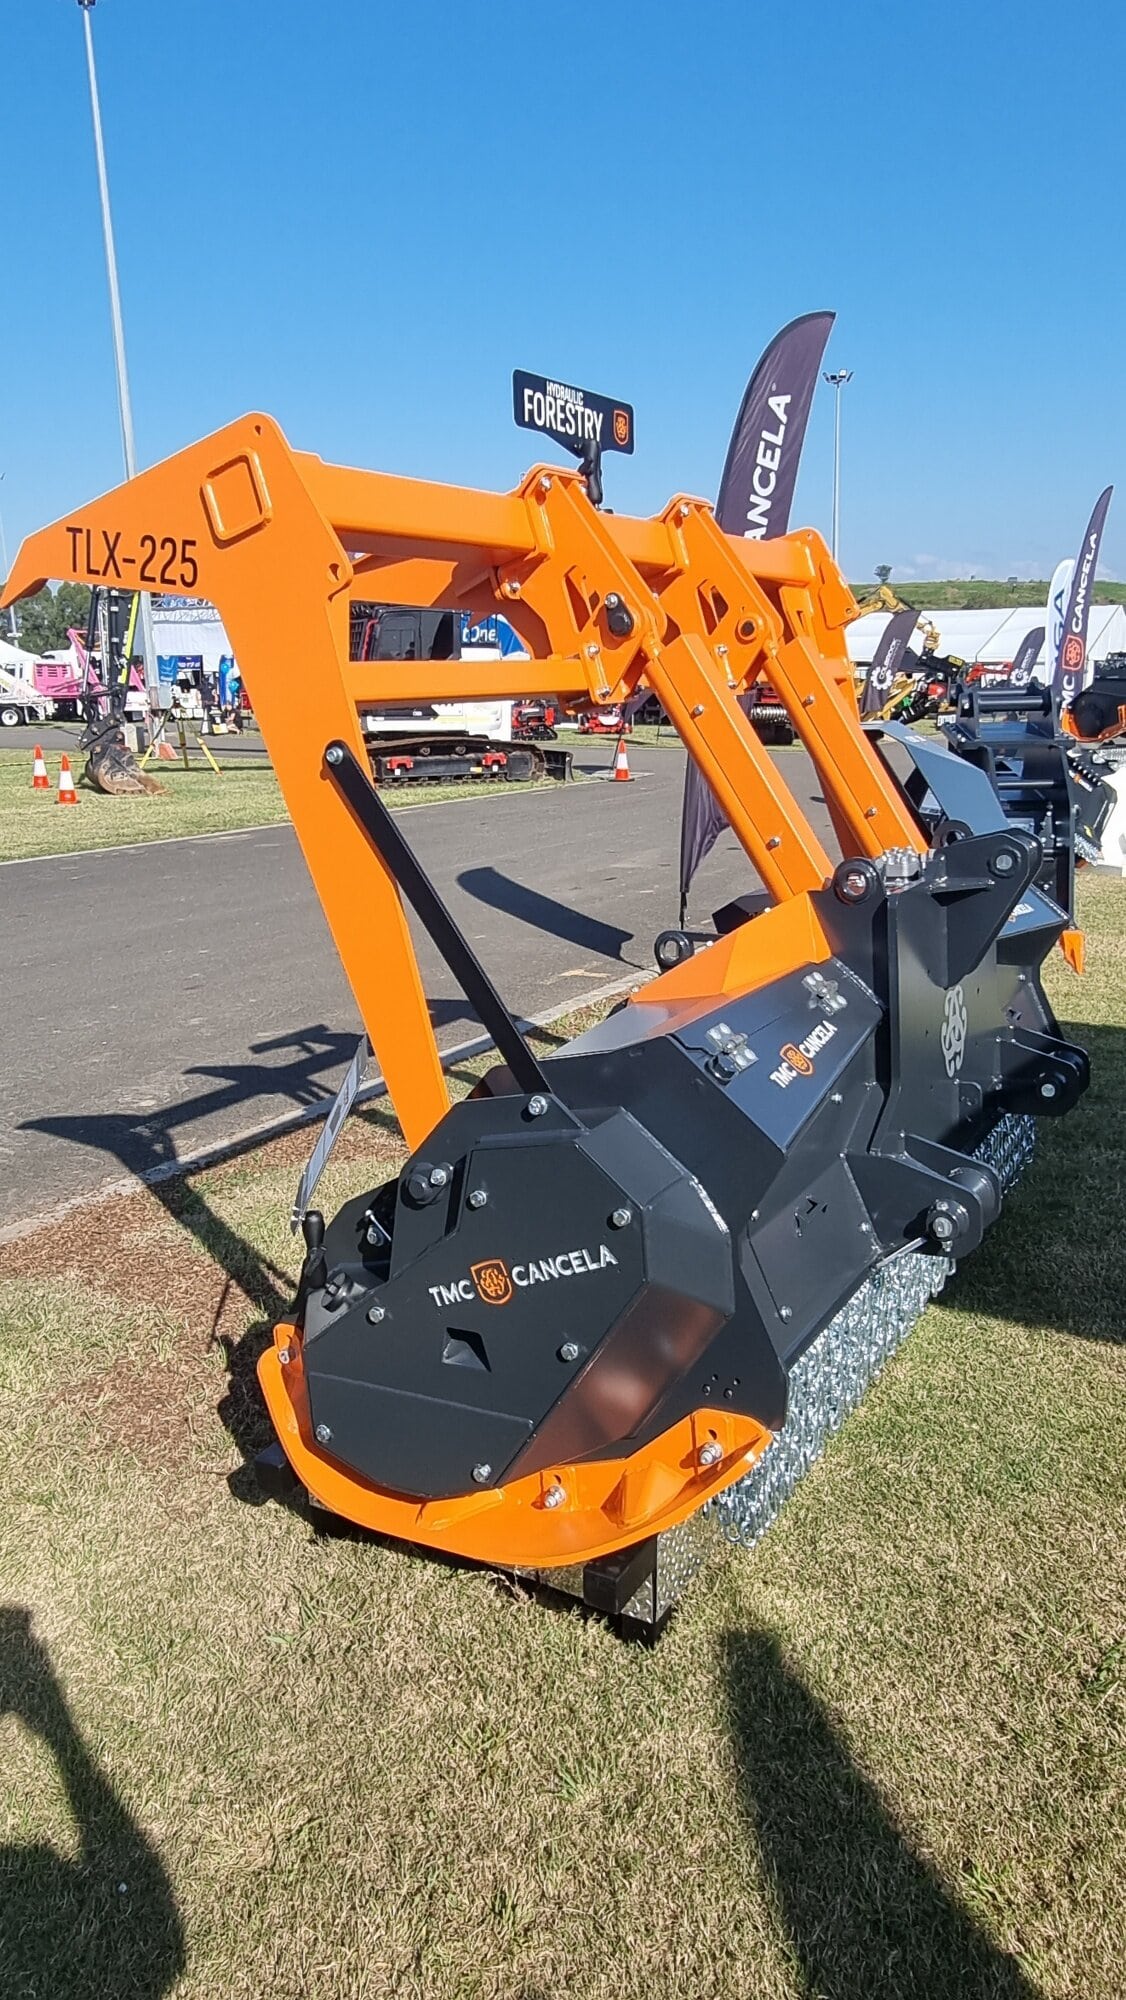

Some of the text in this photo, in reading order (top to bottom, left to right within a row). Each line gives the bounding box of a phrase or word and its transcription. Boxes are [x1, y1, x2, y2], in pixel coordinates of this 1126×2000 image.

[523, 388, 603, 442] FORESTRY
[546, 381, 584, 406] HYDRAULIC
[744, 394, 792, 541] ANCELA
[66, 526, 198, 588] TLX-225
[1072, 533, 1097, 633] CANCELA
[769, 1020, 838, 1089] TMC CANCELA
[428, 1244, 619, 1307] TMC CANCELA
